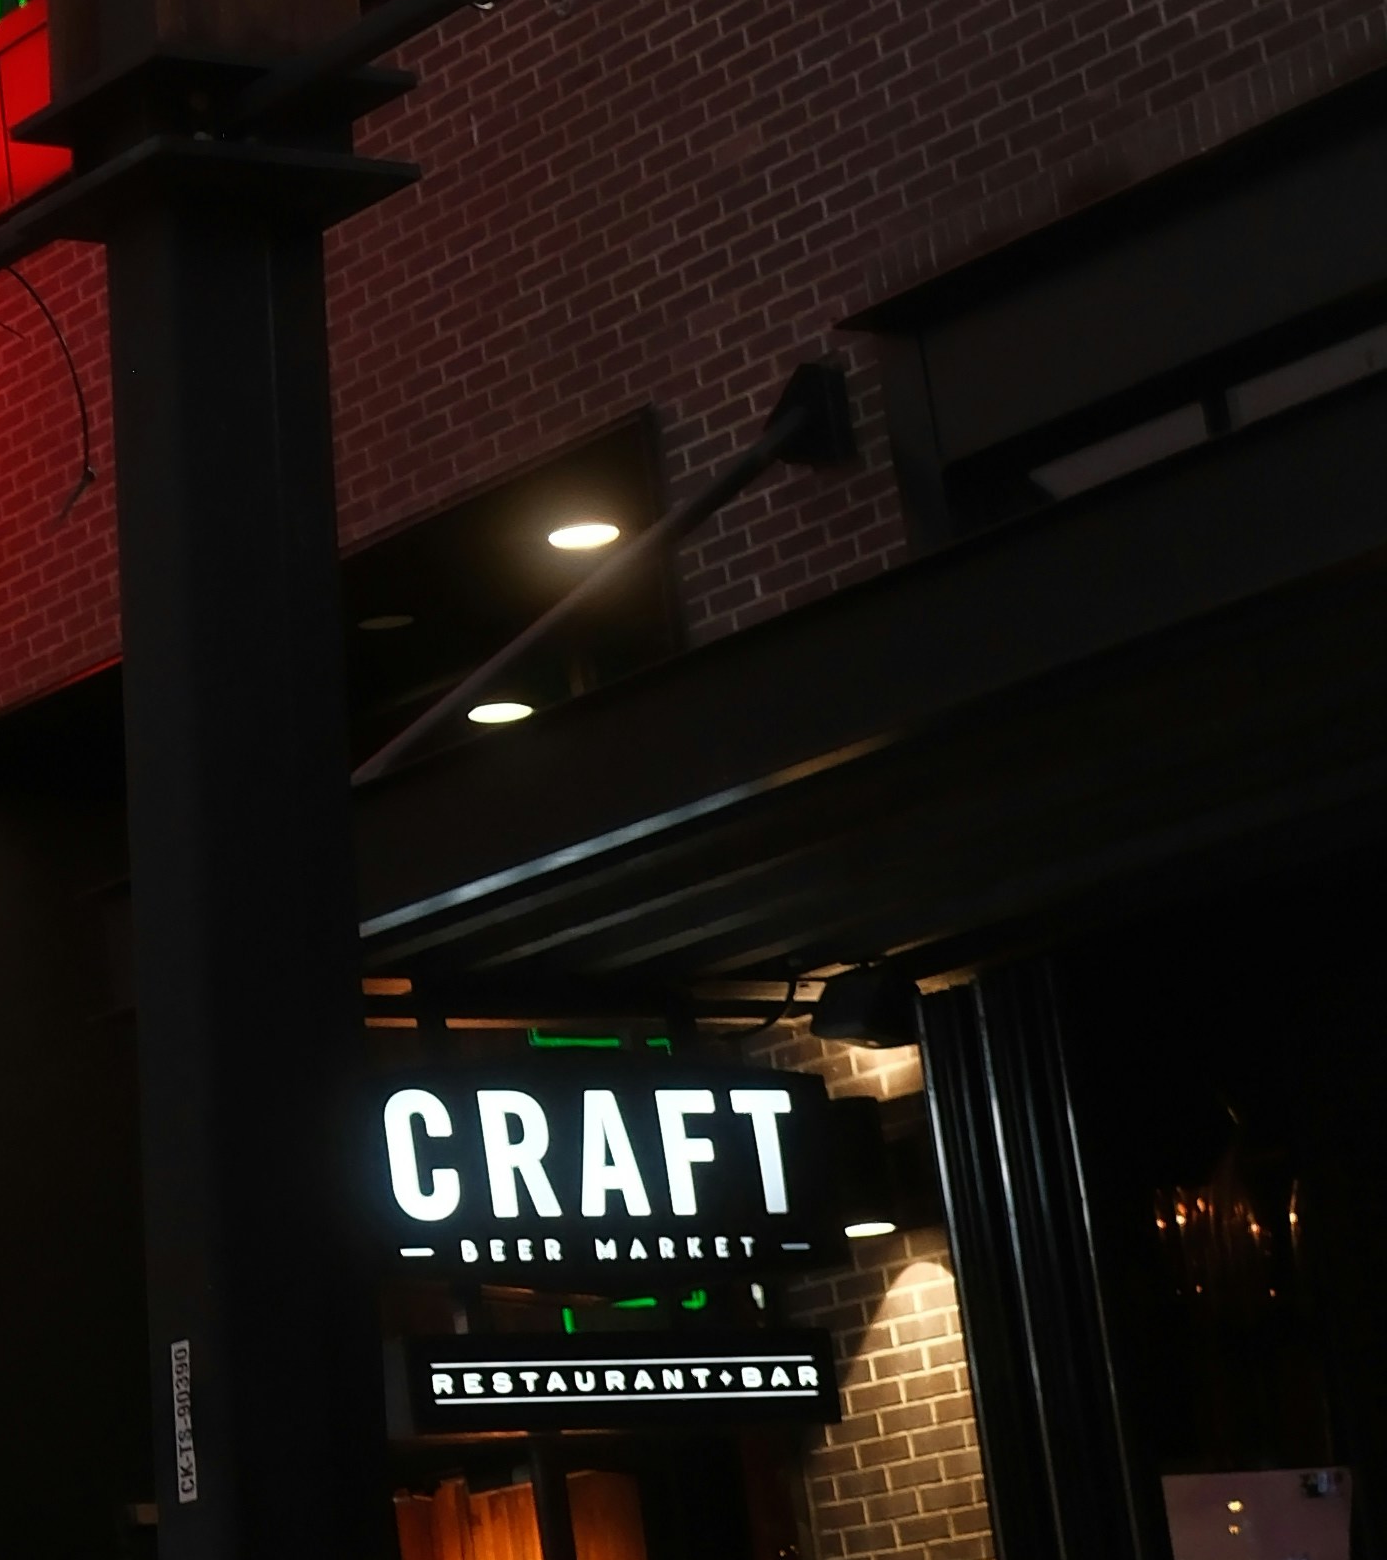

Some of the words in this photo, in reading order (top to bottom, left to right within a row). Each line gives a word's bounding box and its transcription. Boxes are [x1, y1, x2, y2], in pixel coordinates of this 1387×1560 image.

[383, 1088, 793, 1221] CRAFT
[460, 1237, 564, 1263] BEER
[595, 1235, 757, 1261] MARKET
[432, 1366, 711, 1397] RESTAURANT
[741, 1364, 819, 1389] BAR
